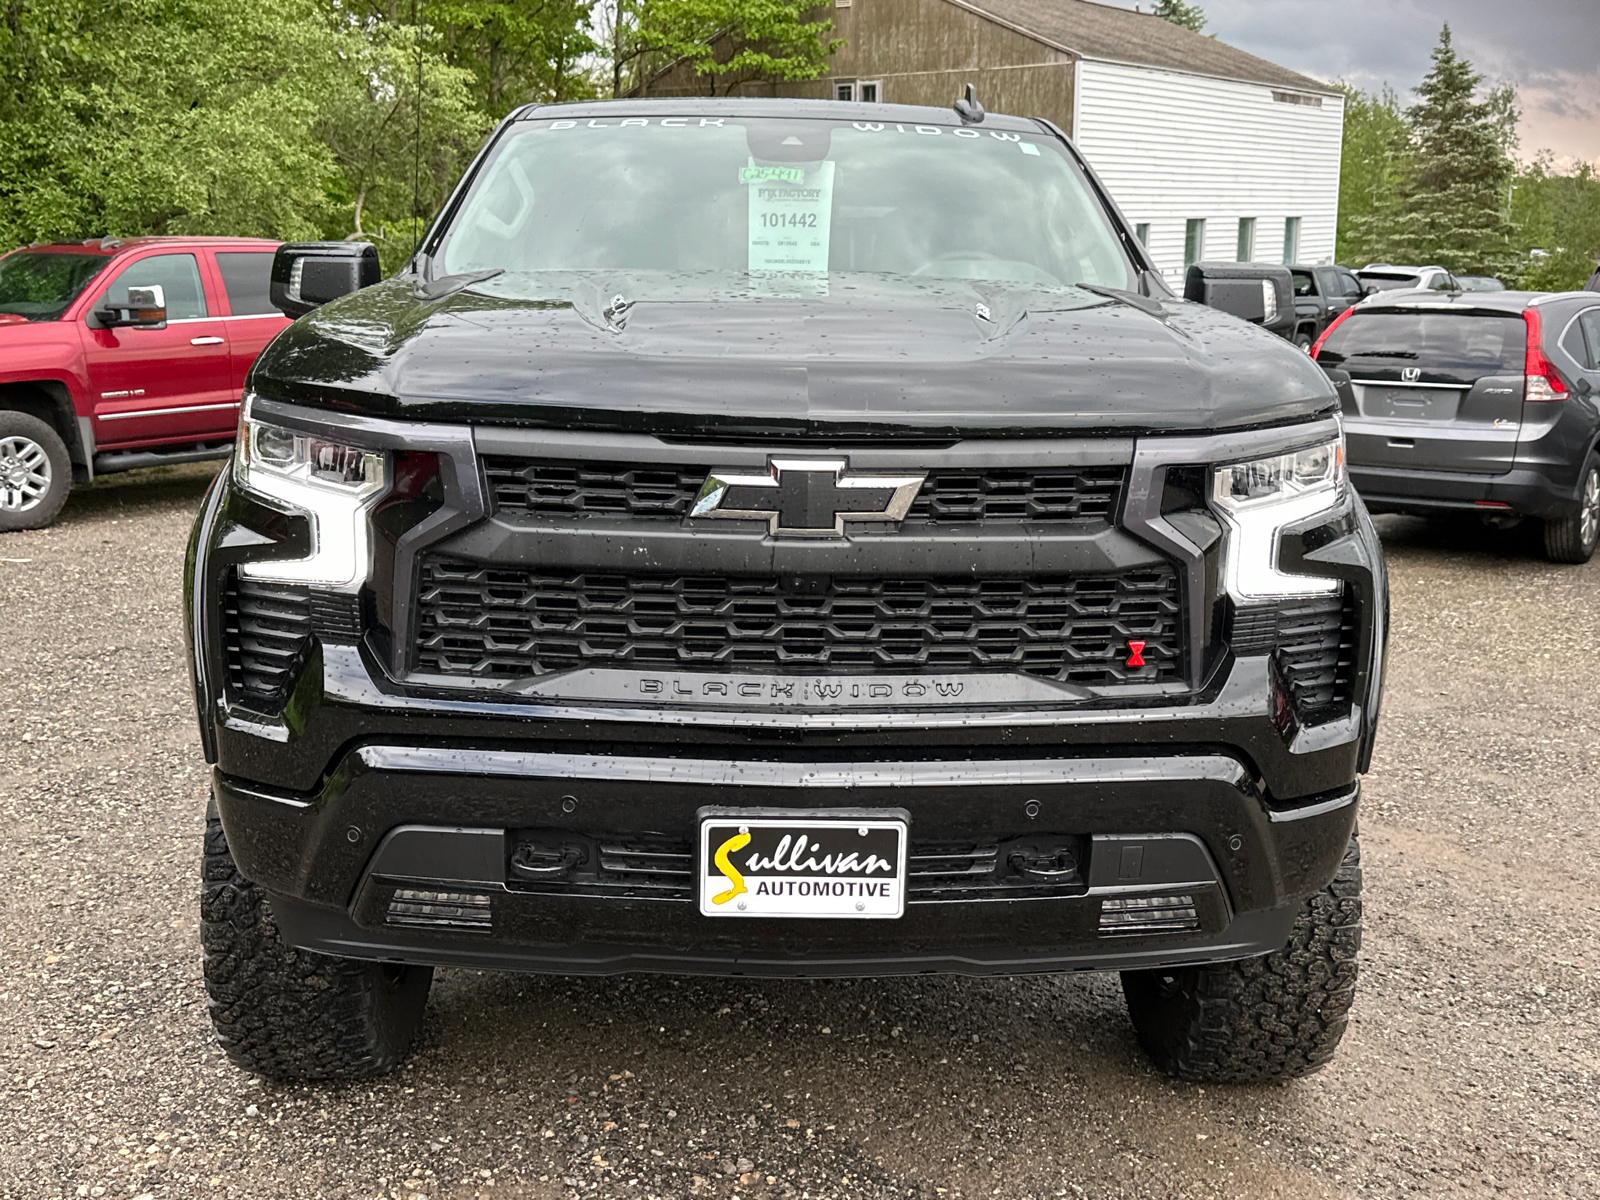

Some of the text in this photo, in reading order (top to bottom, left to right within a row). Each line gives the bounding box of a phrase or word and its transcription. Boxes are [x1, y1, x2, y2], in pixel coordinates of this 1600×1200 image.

[549, 118, 1021, 143] BLACK WIDOW
[758, 189, 821, 198] FOX FACTORY
[760, 212, 817, 228] 101442
[639, 679, 964, 698] BLACK WIDOW
[712, 832, 892, 905] Sullivan
[755, 881, 891, 897] AUTOMOTIVE
